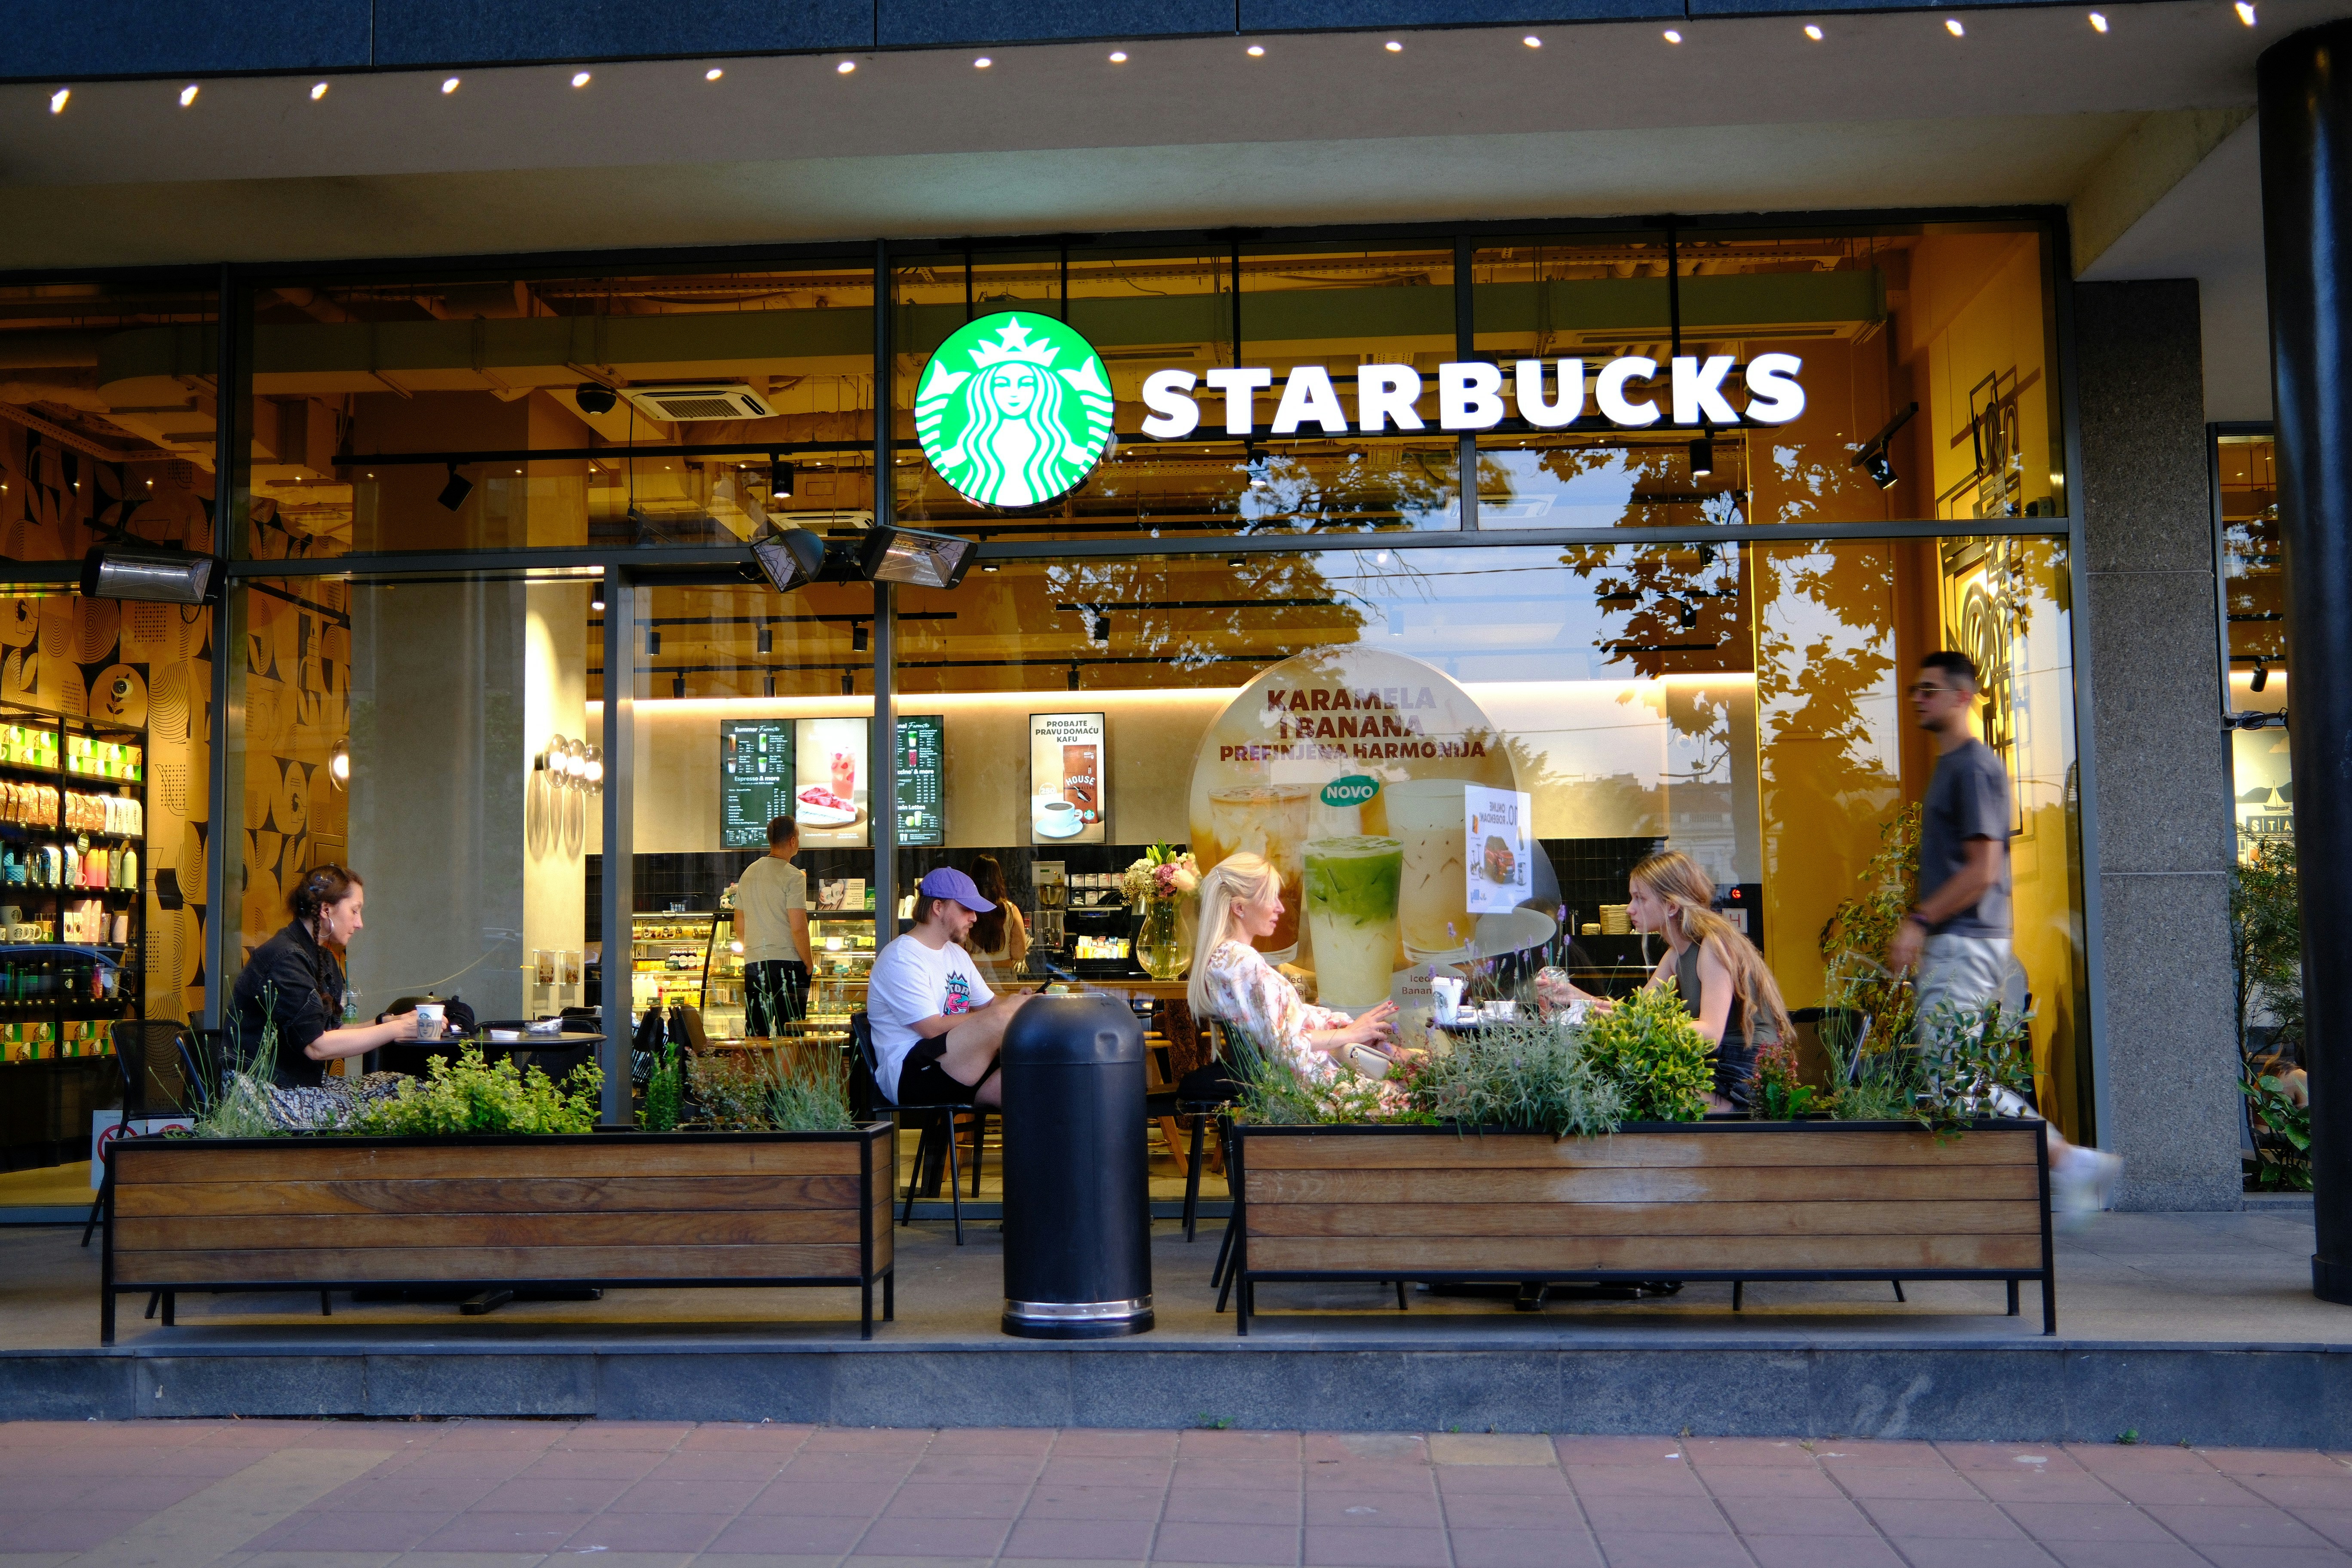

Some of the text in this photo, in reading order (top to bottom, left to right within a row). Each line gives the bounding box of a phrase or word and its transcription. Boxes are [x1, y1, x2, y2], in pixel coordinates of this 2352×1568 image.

[1142, 353, 1806, 439] STARBUCKS
[1267, 687, 1437, 712] KARAMELA
[1063, 726, 1099, 735] DOMAĆU
[1280, 715, 1425, 738] I BANANA
[1220, 741, 1486, 761] PREFINJENA HARMONIJA
[1065, 775, 1096, 786] HOUSE
[1326, 785, 1374, 800] NOVO
